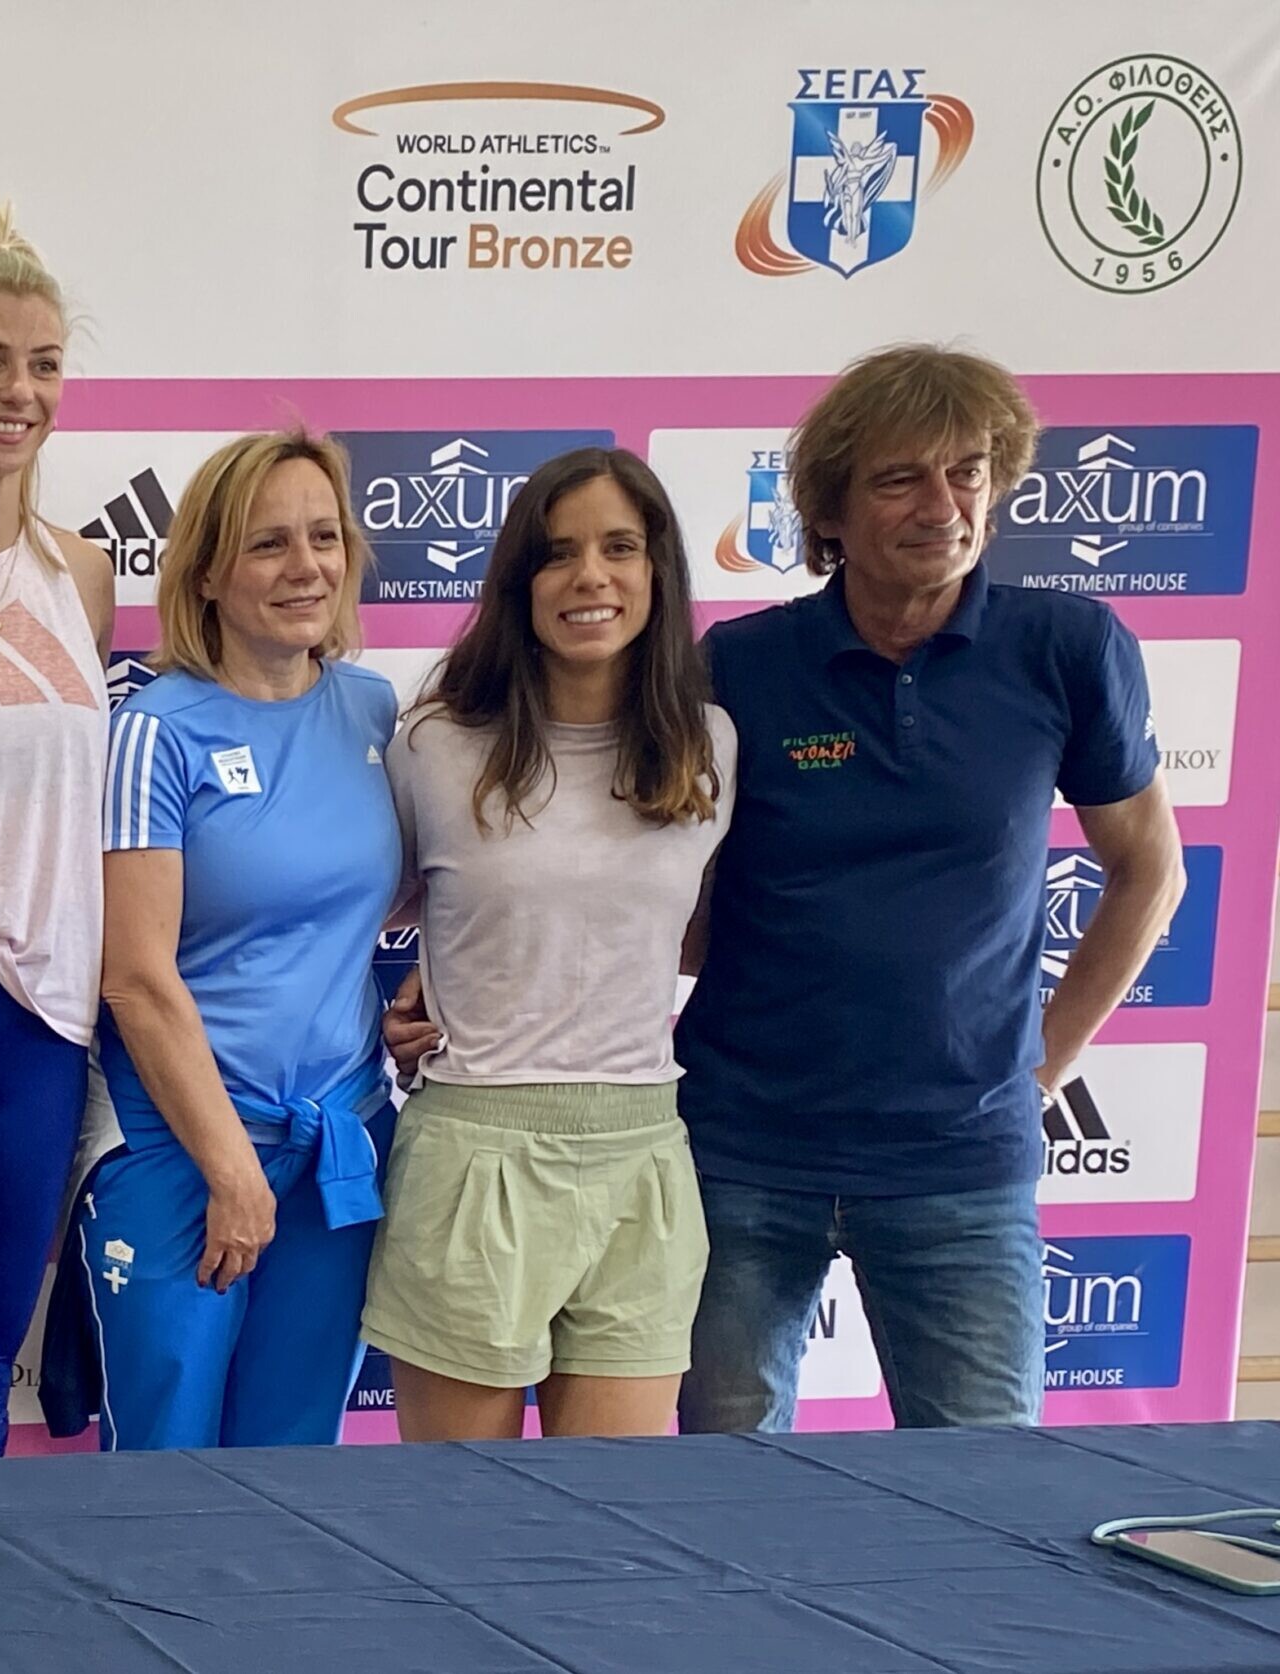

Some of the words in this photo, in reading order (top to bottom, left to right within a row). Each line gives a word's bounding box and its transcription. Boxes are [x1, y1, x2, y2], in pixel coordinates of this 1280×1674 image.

[794, 69, 927, 99] ΣΕΓΑΣ
[1108, 63, 1232, 142] ΦΙΛΟΘΕΗΣ
[396, 135, 476, 154] WORLD
[480, 135, 598, 154] ATHLETICS
[357, 164, 636, 213] Continental
[353, 223, 457, 270] Tour
[468, 224, 633, 270] Bronze
[1090, 250, 1184, 286] 1956
[1010, 470, 1207, 525] axum
[1118, 524, 1144, 534] group
[1157, 520, 1204, 533] companies
[379, 580, 486, 599] INVESTMENT
[1130, 573, 1188, 591] HOUSE
[782, 731, 856, 748] FILOTHEI
[1070, 1369, 1124, 1386] HOUSE
